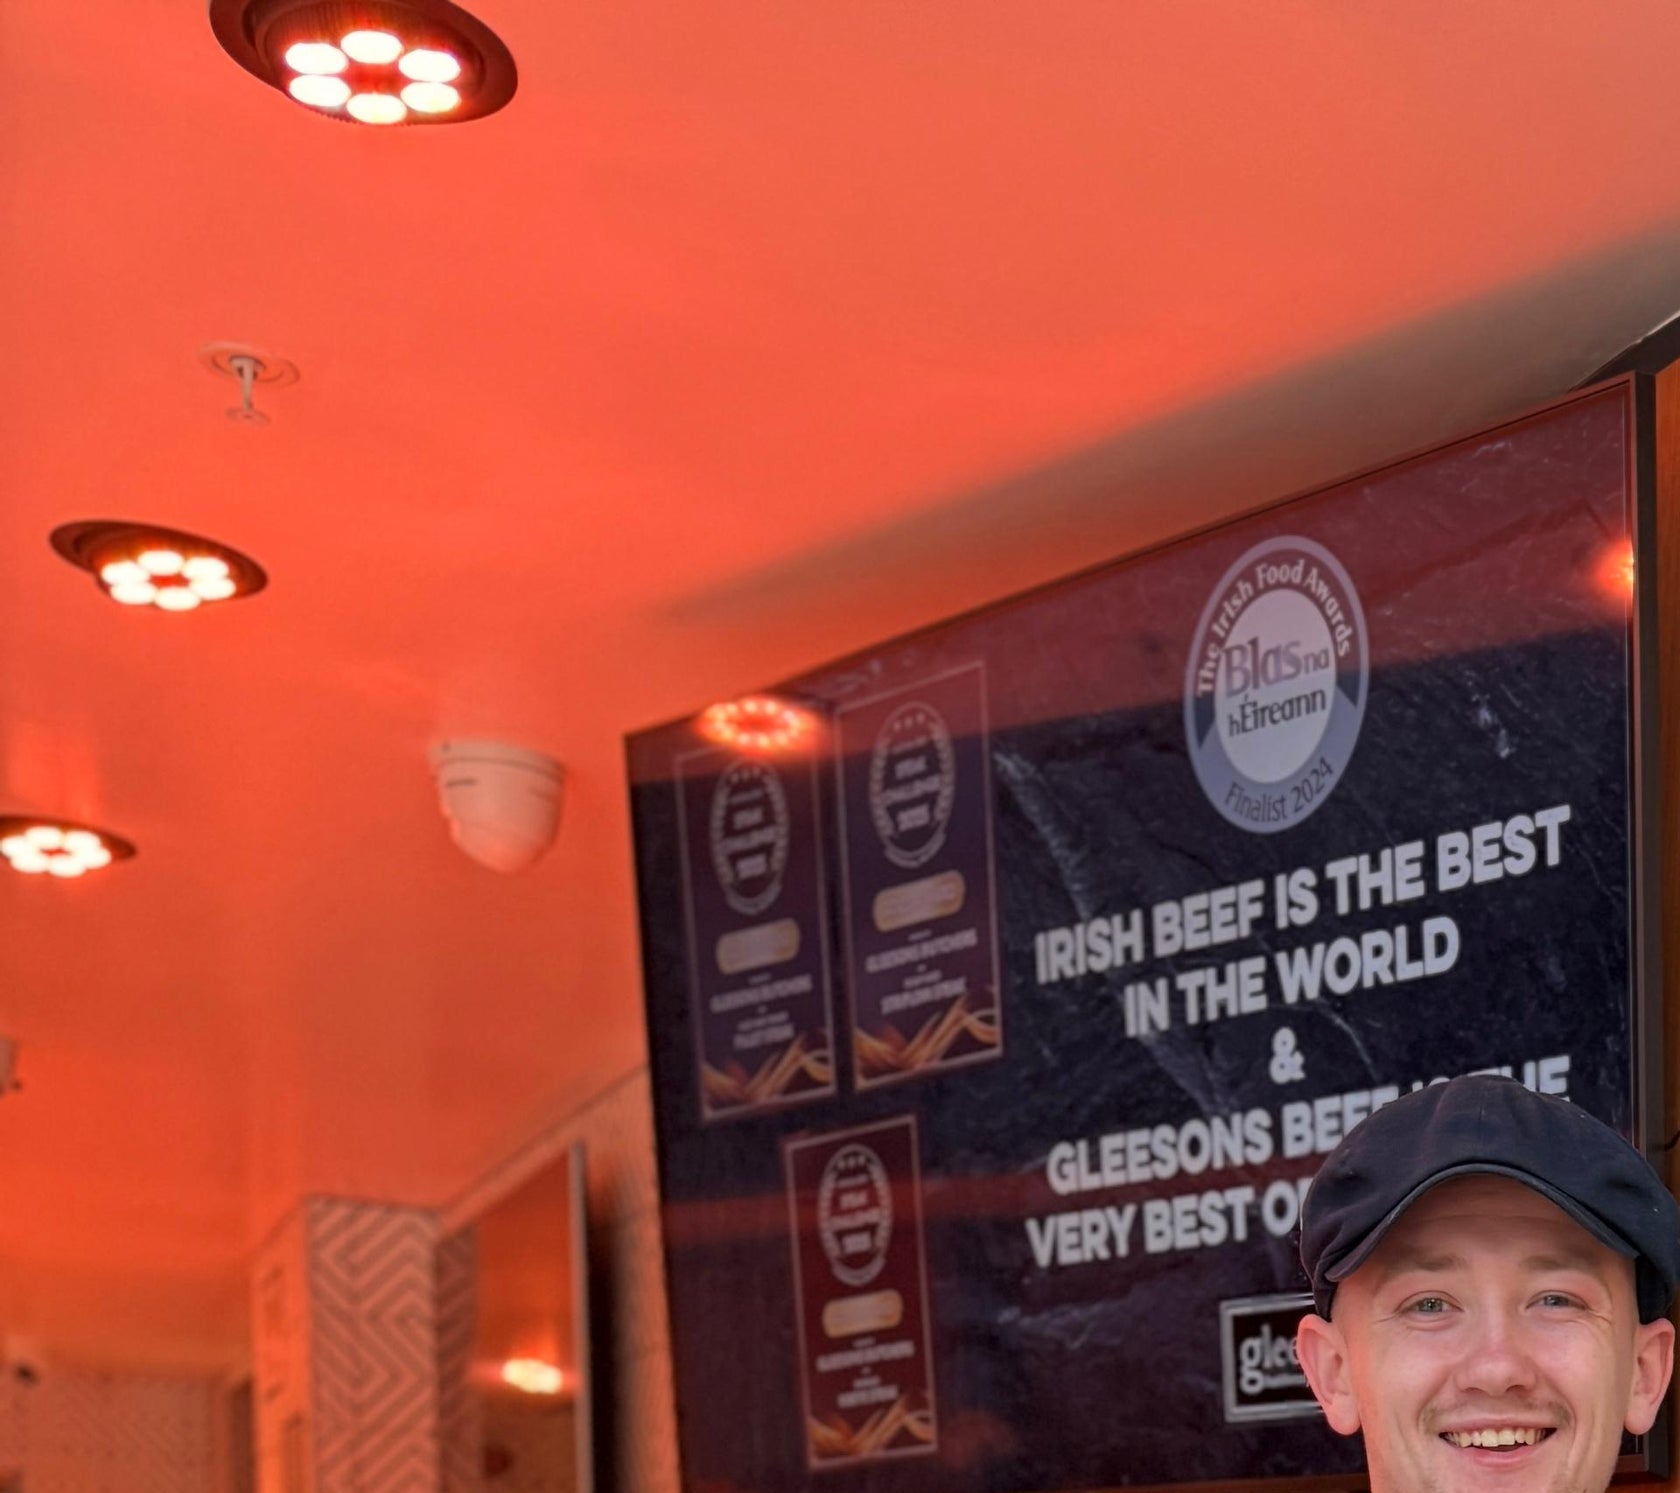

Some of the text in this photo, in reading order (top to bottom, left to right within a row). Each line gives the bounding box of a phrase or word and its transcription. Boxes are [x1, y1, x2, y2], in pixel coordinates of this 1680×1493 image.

[1197, 559, 1353, 697] The Irish Food Awards
[1222, 636, 1330, 698] Blas na
[1227, 689, 1326, 737] hÉireann
[1225, 756, 1334, 823] Finalist 2024
[1035, 909, 1144, 985] IRISH
[1152, 878, 1266, 957] BEEF
[1275, 867, 1318, 929] IS
[1325, 840, 1425, 916] THE
[1437, 804, 1571, 893] BEST
[1123, 916, 1460, 1038] IN THE WORLD
[1268, 1026, 1306, 1084] &
[1046, 1106, 1273, 1196] GLEESONS
[1026, 1178, 1308, 1269] VERY BEST O
